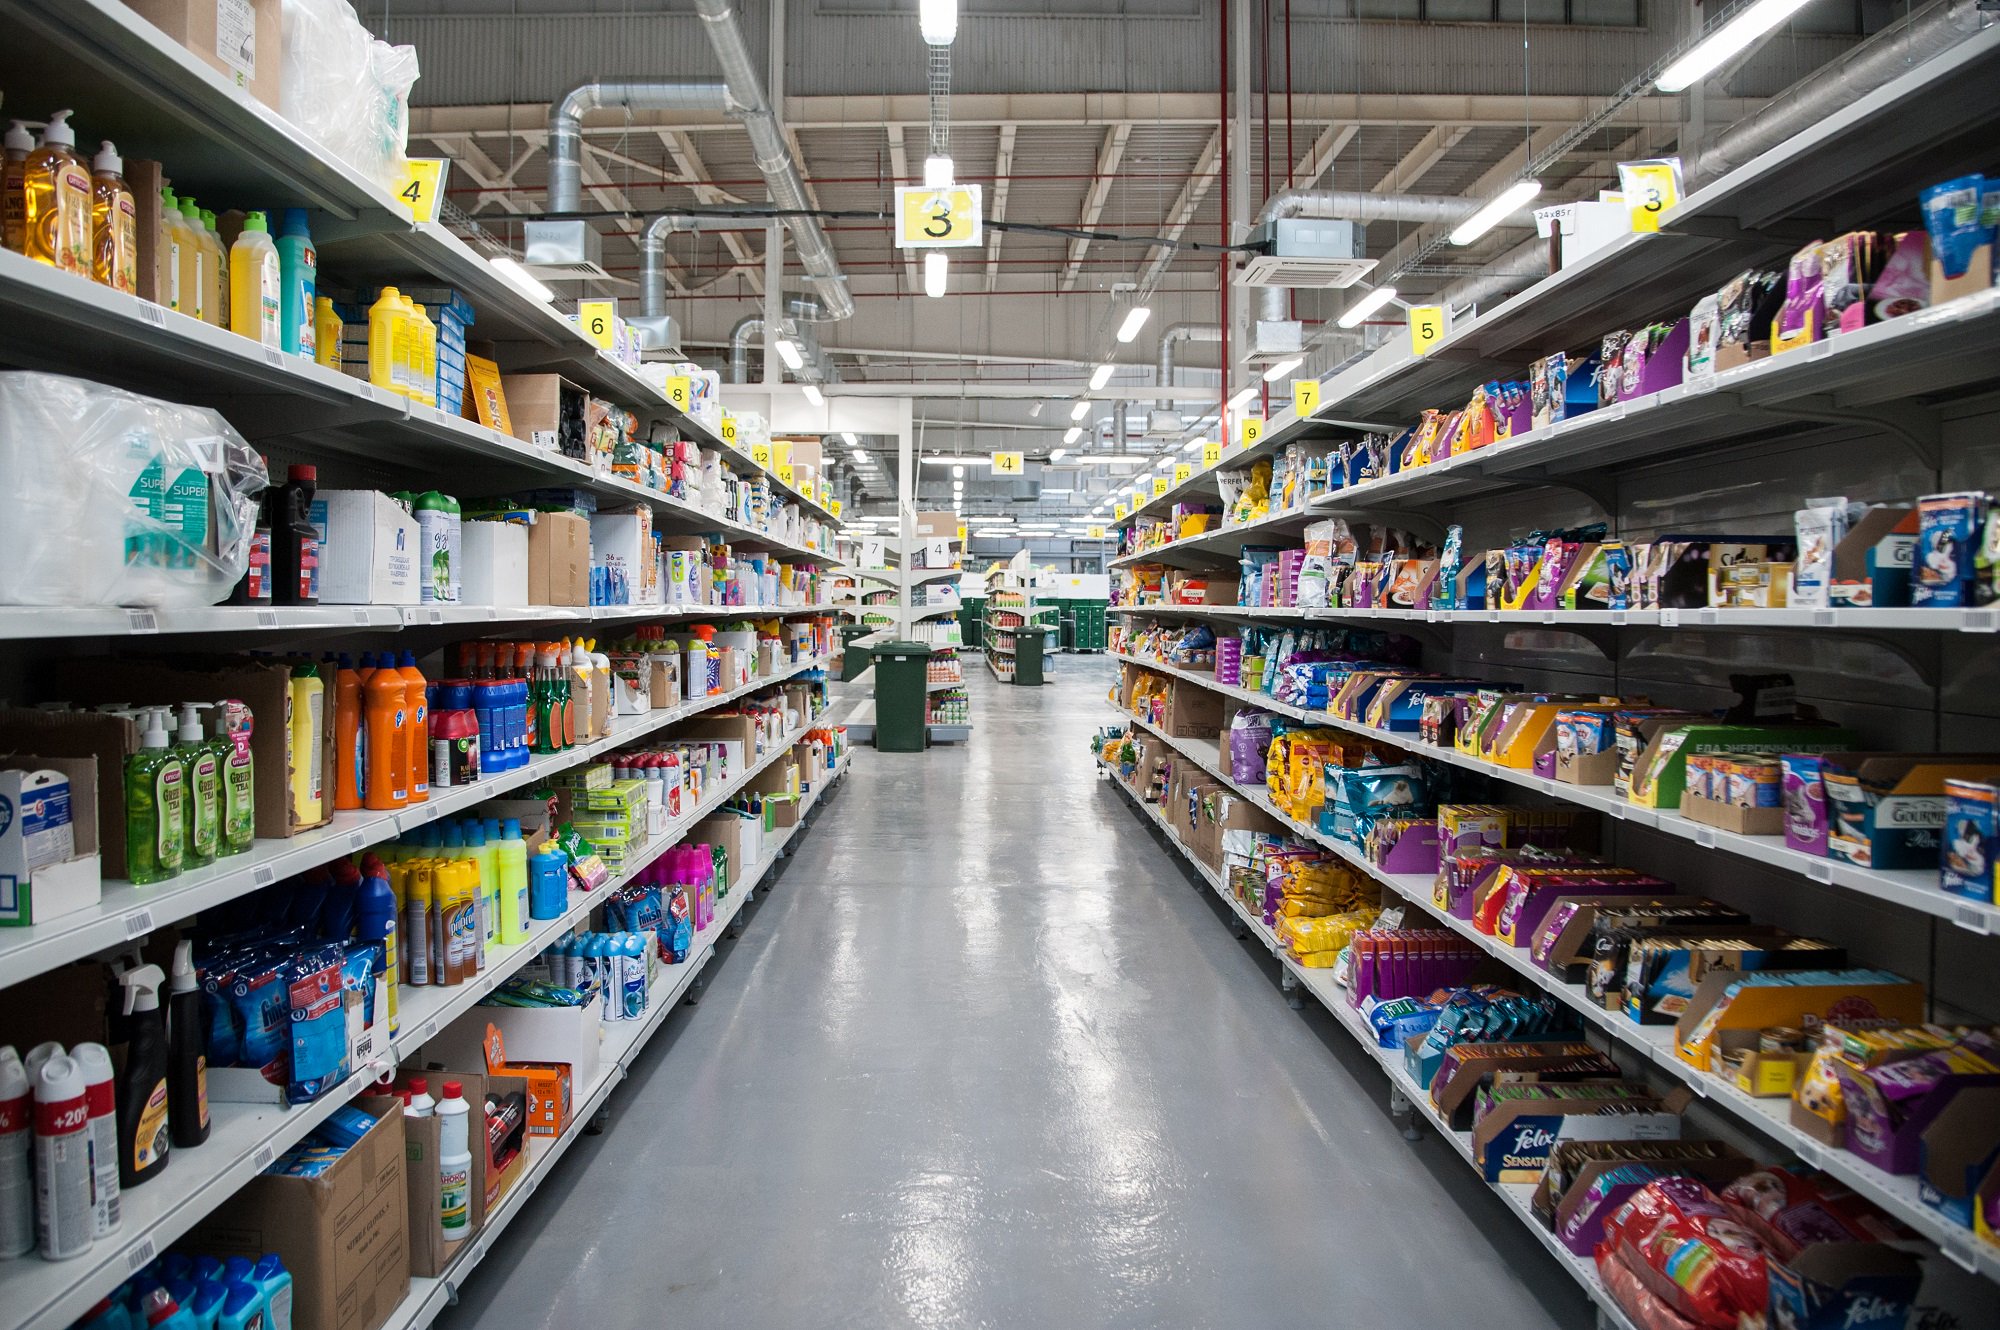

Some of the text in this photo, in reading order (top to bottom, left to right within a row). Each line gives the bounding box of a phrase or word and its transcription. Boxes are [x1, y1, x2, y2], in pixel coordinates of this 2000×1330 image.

[402, 180, 421, 203] 4
[1644, 188, 1663, 212] 3
[924, 199, 953, 238] 3
[591, 317, 604, 335] 6
[1422, 322, 1434, 340] 5
[673, 388, 682, 402] 8
[1301, 392, 1310, 404] 7
[721, 427, 735, 438] 10
[1248, 427, 1257, 438] 9
[1206, 450, 1219, 460] 11
[1002, 458, 1012, 471] 4
[780, 472, 791, 480] 14
[801, 487, 812, 495] 16
[871, 543, 878, 555] 7
[934, 543, 942, 556] 4
[1408, 692, 1426, 709] fel
[638, 908, 662, 926] finish
[356, 1038, 373, 1059] finish
[1513, 1129, 1556, 1155] felix
[1502, 1154, 1549, 1168] SENSATI
[1844, 1296, 1898, 1330] felix
